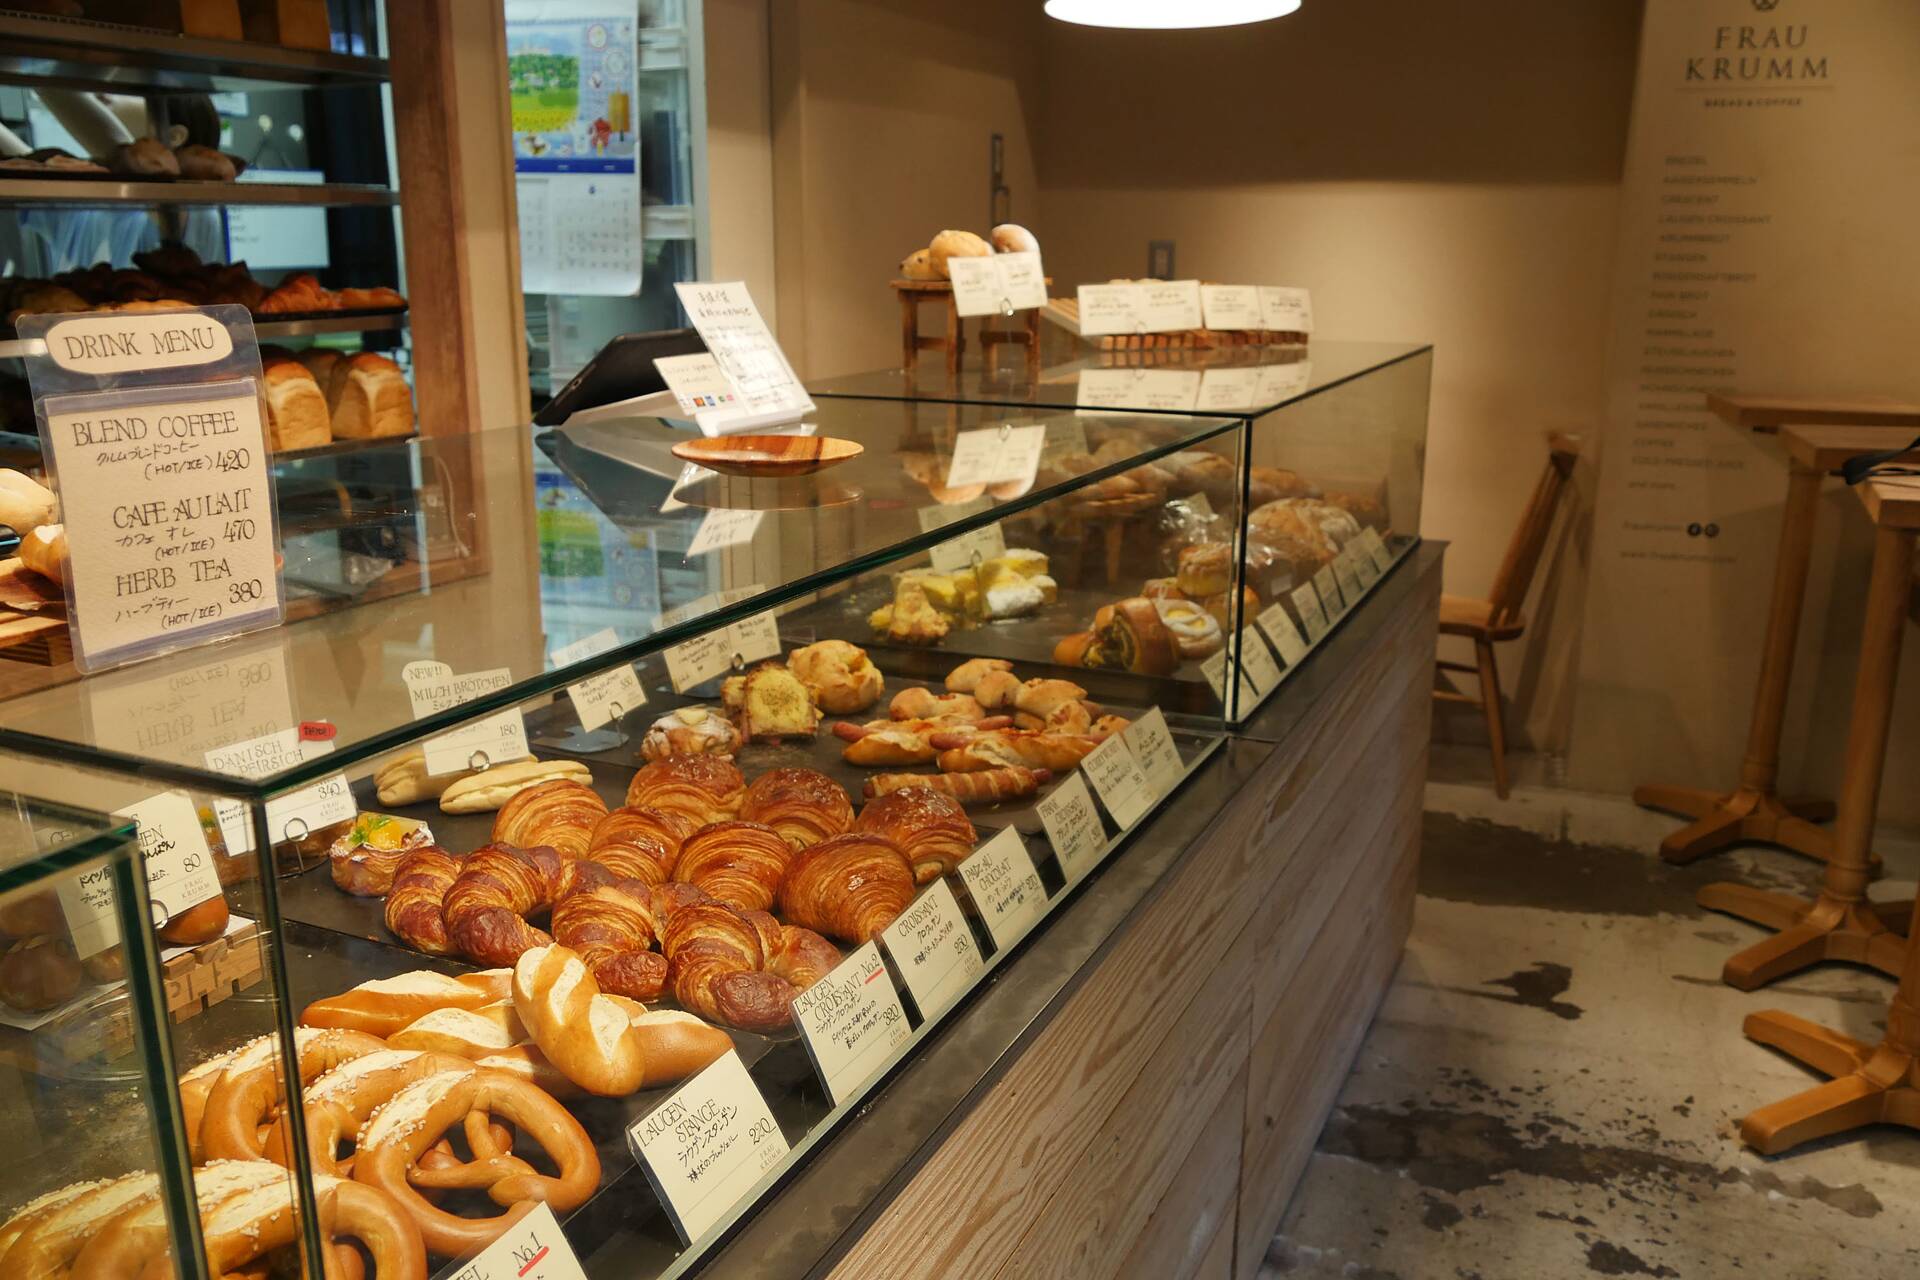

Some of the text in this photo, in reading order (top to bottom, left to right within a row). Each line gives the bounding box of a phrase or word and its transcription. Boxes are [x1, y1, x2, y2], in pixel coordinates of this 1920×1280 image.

[1715, 24, 1808, 50] FRAU
[1685, 57, 1829, 81] KRUMM
[63, 327, 215, 360] DRINK MENU
[72, 411, 239, 446] BLEND COFFEE
[215, 448, 250, 473] 420
[113, 500, 168, 529] CAFE
[223, 519, 256, 543] 470
[115, 558, 233, 598] HERB TEA
[229, 578, 263, 604] 380
[413, 685, 451, 702] MILCH
[499, 723, 518, 737] 180
[318, 782, 342, 800] 340
[183, 852, 202, 873] 80
[897, 894, 939, 937] CROISSANT
[795, 976, 835, 1016] LAUGEN
[814, 971, 862, 1021] CROISSANT
[882, 1003, 901, 1026] 320
[636, 1096, 688, 1147] LAUGEN
[674, 1098, 721, 1143] STANGE
[748, 1117, 777, 1146] 220
